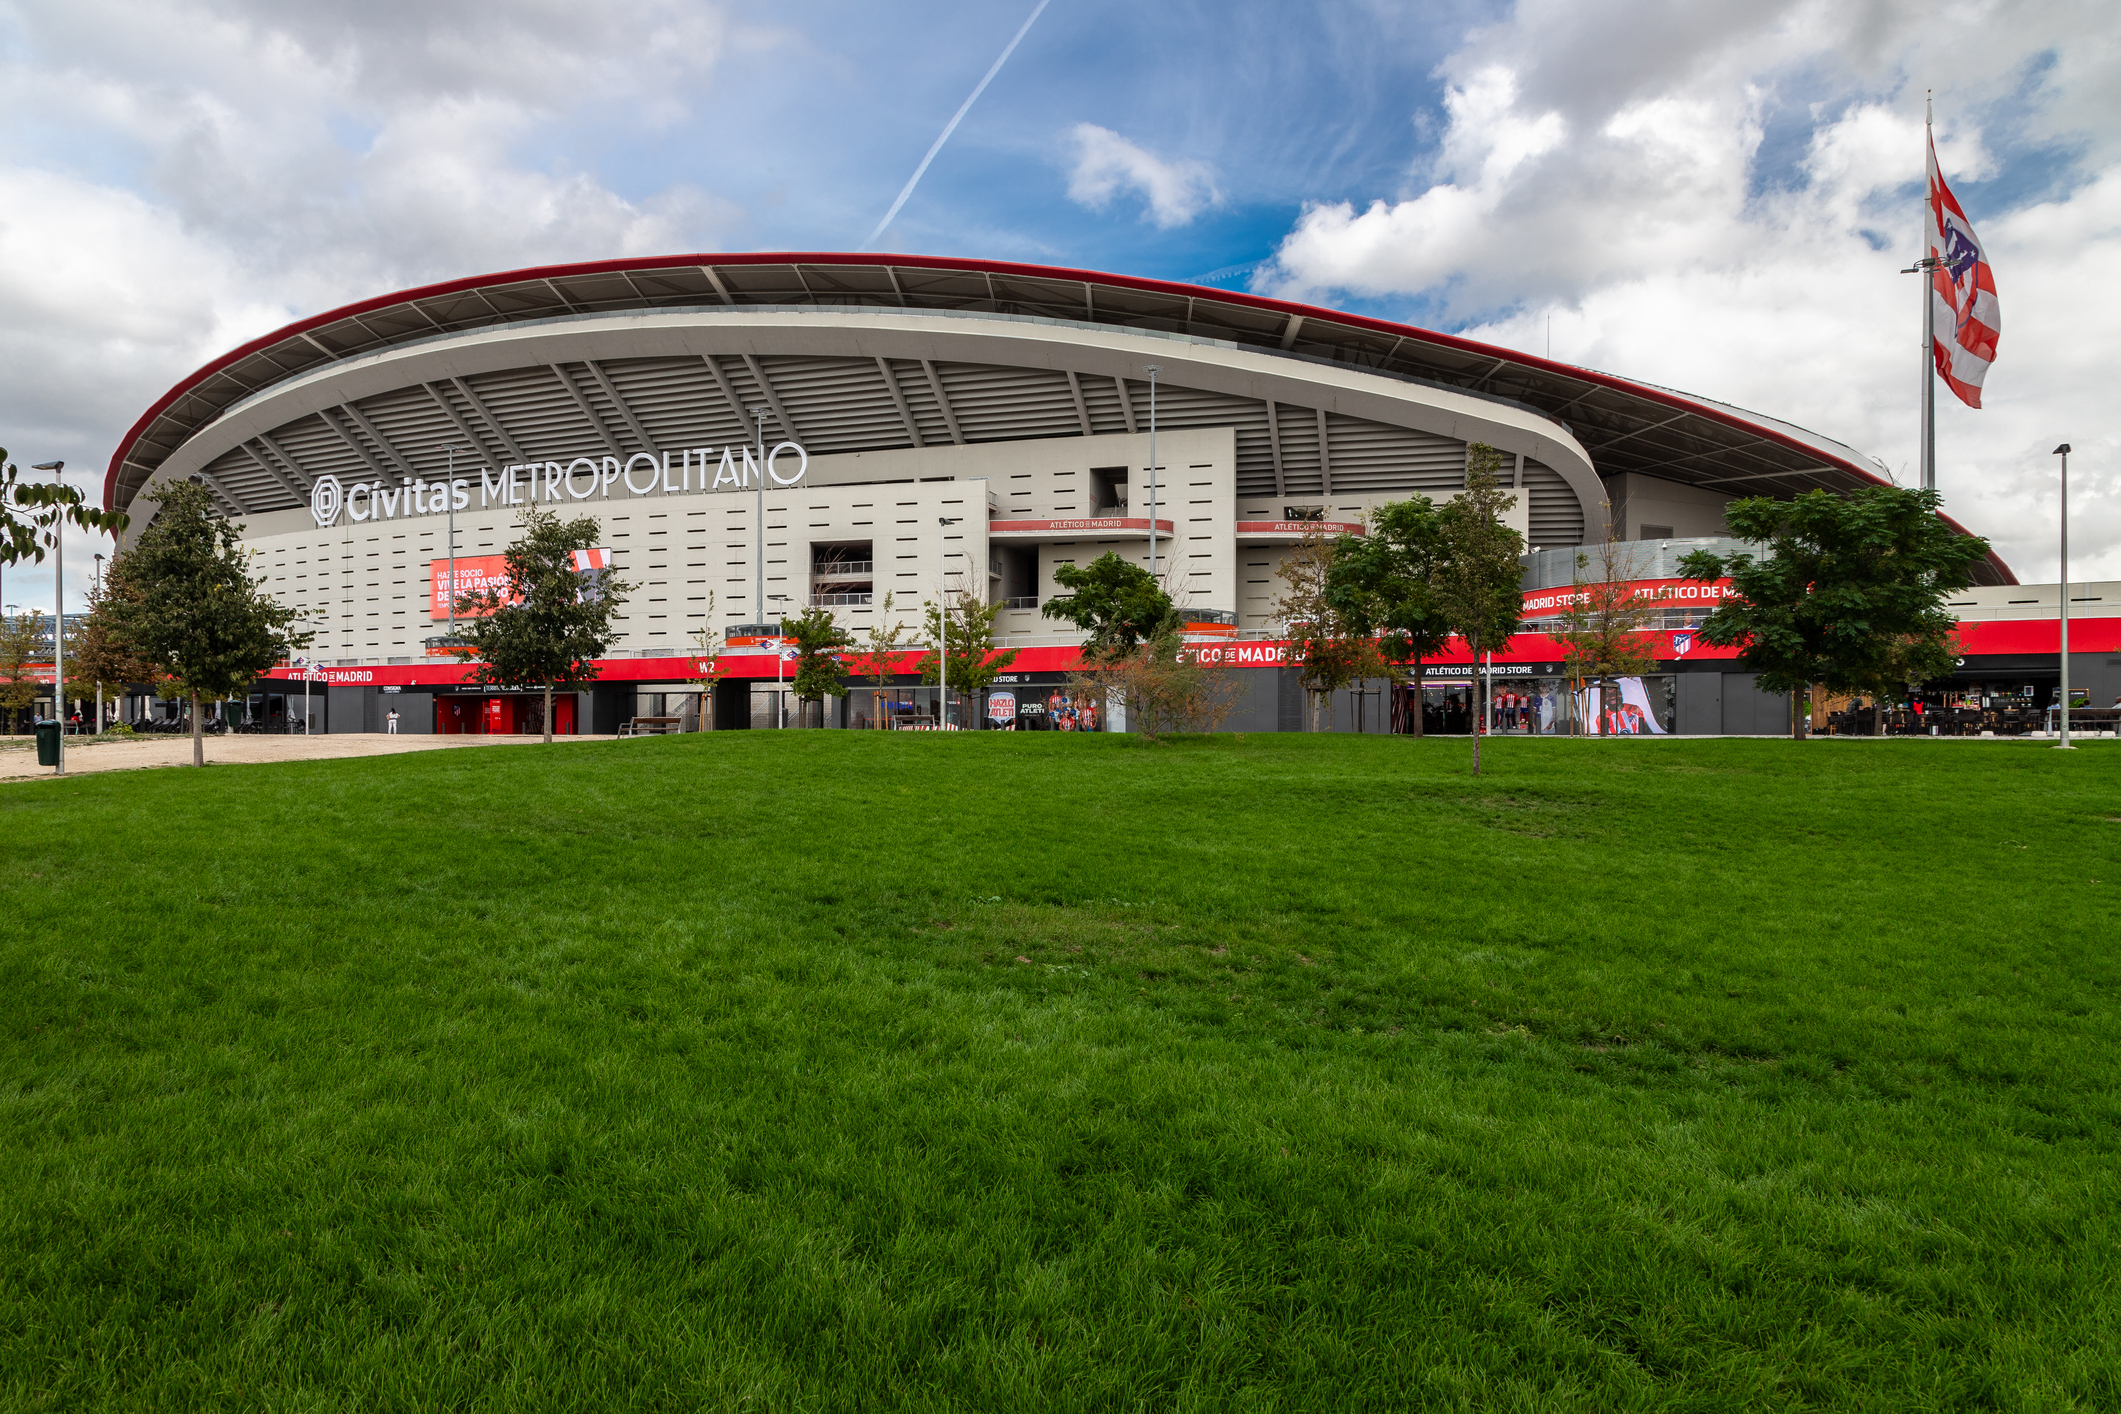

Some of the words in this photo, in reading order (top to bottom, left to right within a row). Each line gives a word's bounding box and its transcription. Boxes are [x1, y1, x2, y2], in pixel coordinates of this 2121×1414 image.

[347, 477, 471, 521] Cívitas
[481, 441, 808, 507] METROPOLITANO
[1049, 519, 1084, 528] ATLÉTICO
[1091, 520, 1122, 528] MADRID
[460, 568, 483, 578] SOCIO
[460, 578, 473, 589] LA
[474, 572, 513, 588] PASIÓN
[1633, 584, 1698, 600] ATLÉTICO
[1701, 586, 1719, 598] DE
[1522, 596, 1555, 611] MADRID
[1555, 592, 1591, 607] STORE
[1224, 649, 1235, 661] DE
[699, 661, 715, 673] W2
[1425, 666, 1461, 676] ATLÉTICO
[1462, 667, 1473, 675] DE
[1507, 666, 1533, 674] STORE
[336, 671, 373, 682] MADRID
[998, 675, 1018, 683] STORE
[989, 698, 1014, 708] HAZLO
[989, 708, 1014, 717] ATLETI
